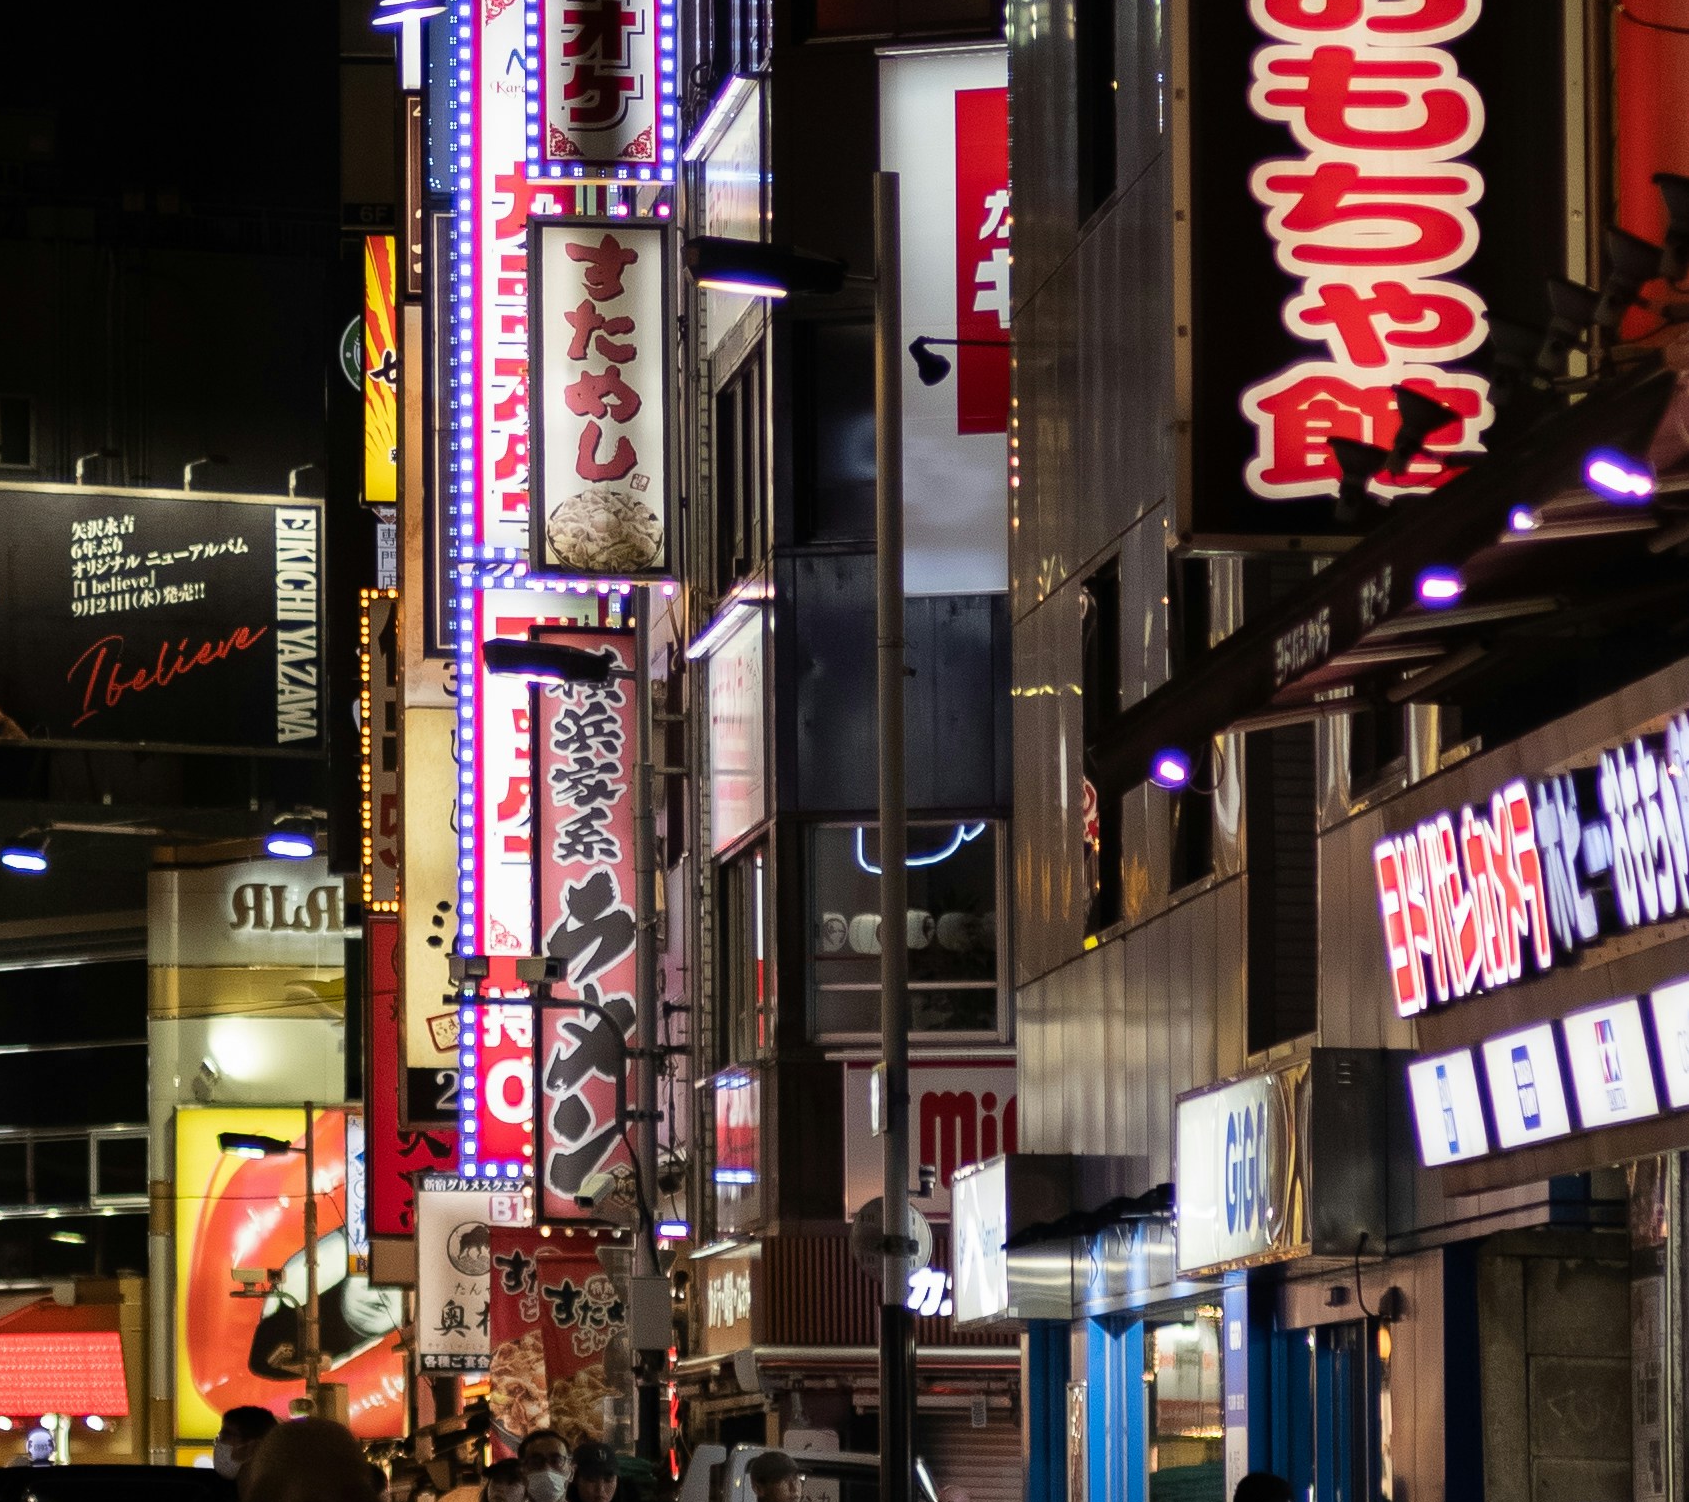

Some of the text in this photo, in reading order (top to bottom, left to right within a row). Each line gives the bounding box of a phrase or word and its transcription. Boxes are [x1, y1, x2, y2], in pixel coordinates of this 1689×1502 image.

[71, 515, 135, 541] 矢沢永吉
[70, 538, 124, 560] 6年ぶり
[71, 536, 249, 579] オリジナル ニューアルバム
[275, 508, 319, 744] EIKICHI YAZAWA
